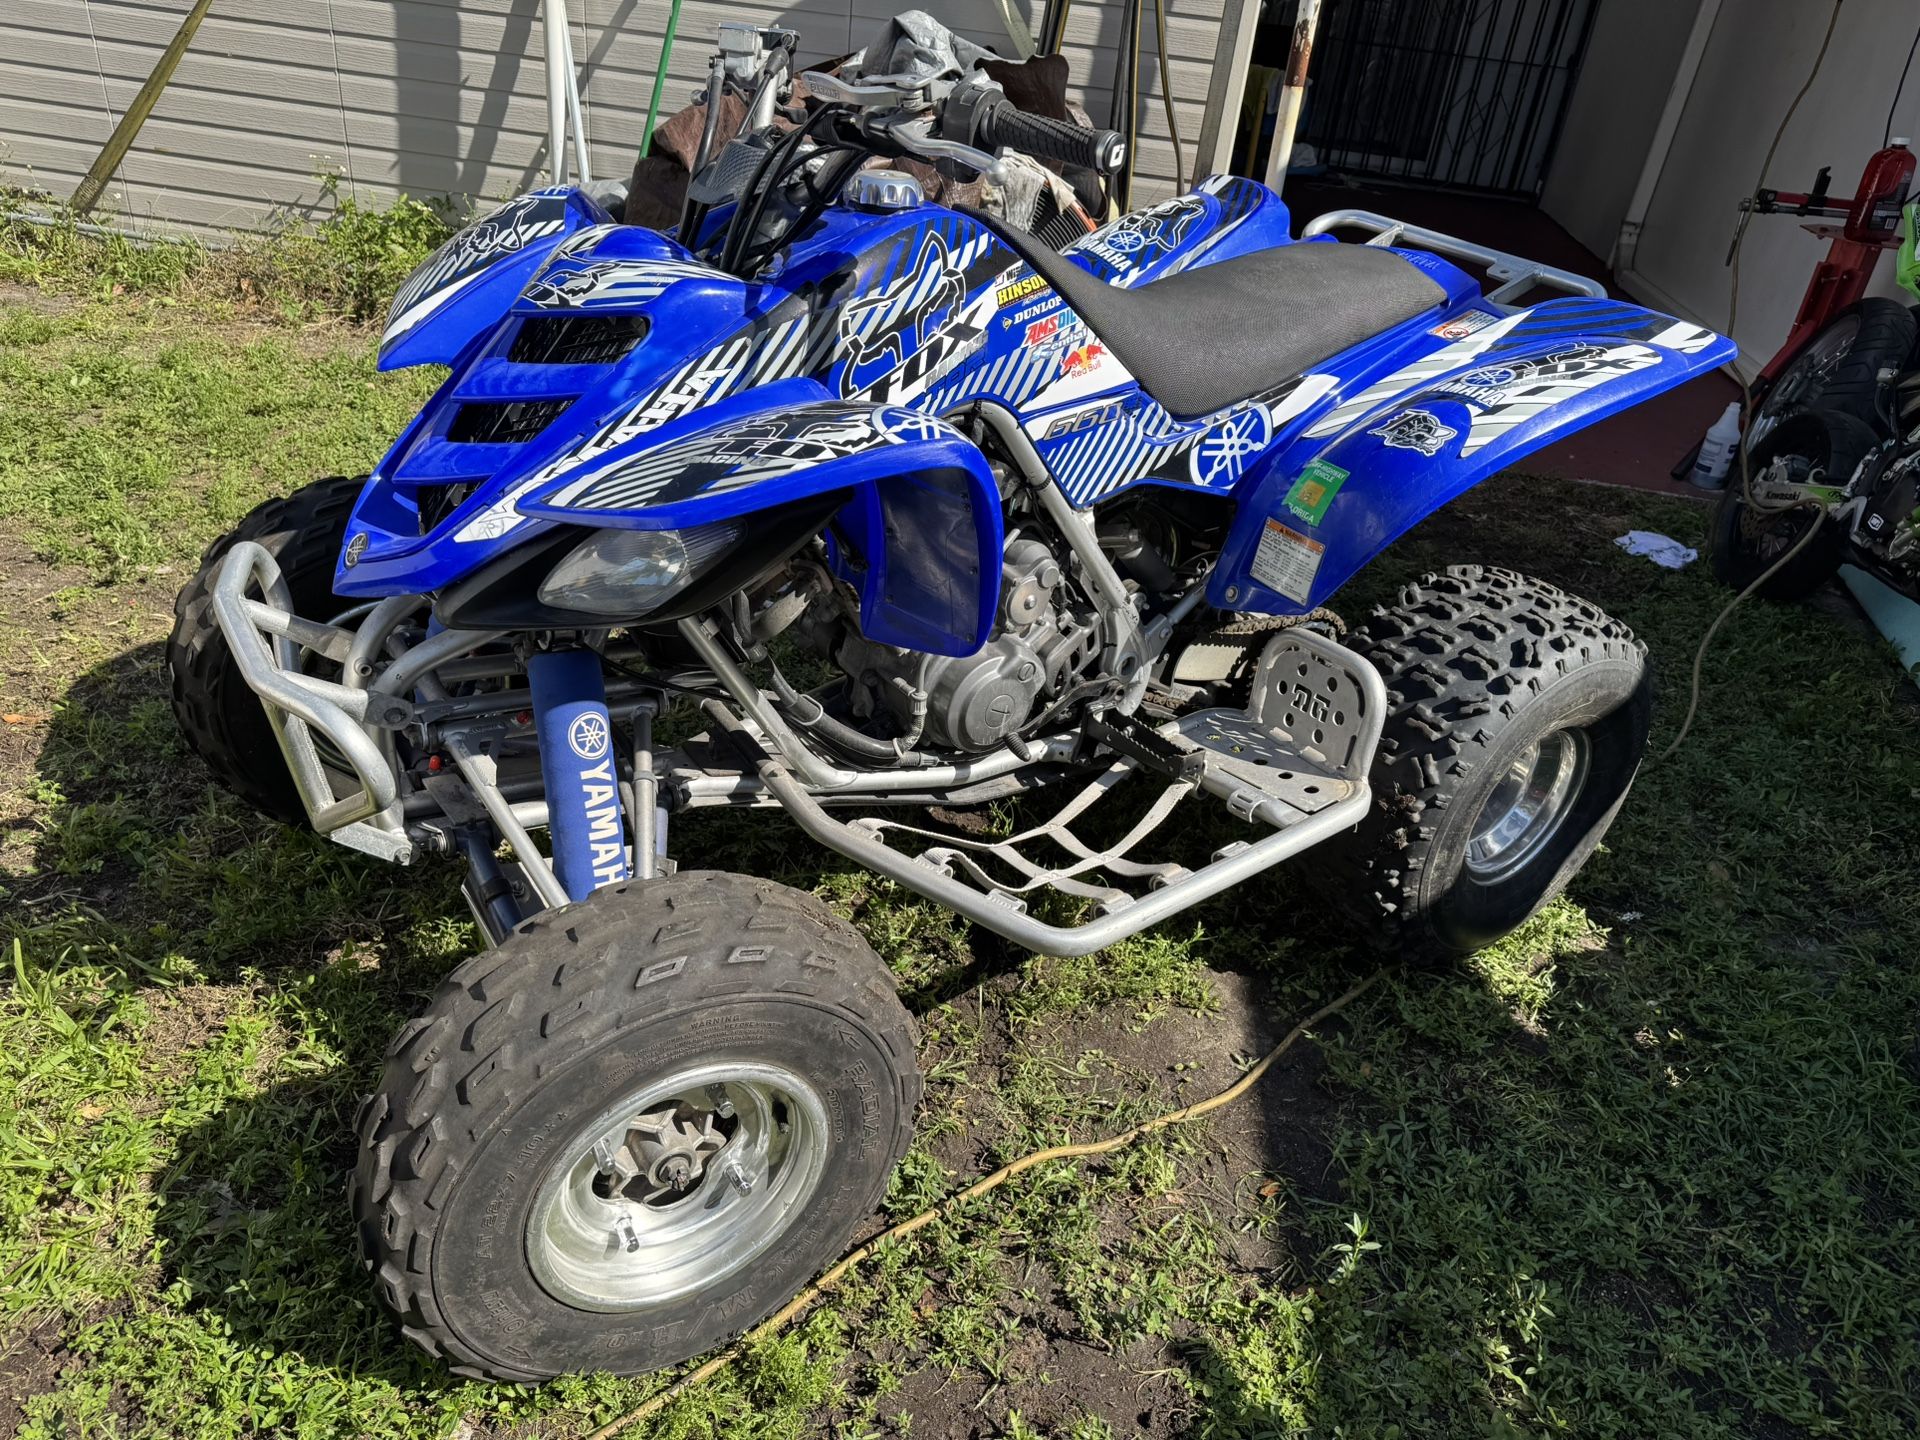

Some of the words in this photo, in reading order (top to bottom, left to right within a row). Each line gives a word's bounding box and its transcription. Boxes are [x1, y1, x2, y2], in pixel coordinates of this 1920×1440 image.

[1077, 237, 1133, 273] YAMAHA
[1013, 296, 1063, 325] DUNLOP
[846, 302, 985, 403] FOX
[1070, 363, 1089, 379] Red
[1088, 360, 1102, 373] Bull
[1043, 402, 1124, 441] 660
[1291, 683, 1331, 723] DG
[580, 758, 622, 888] YAMAH
